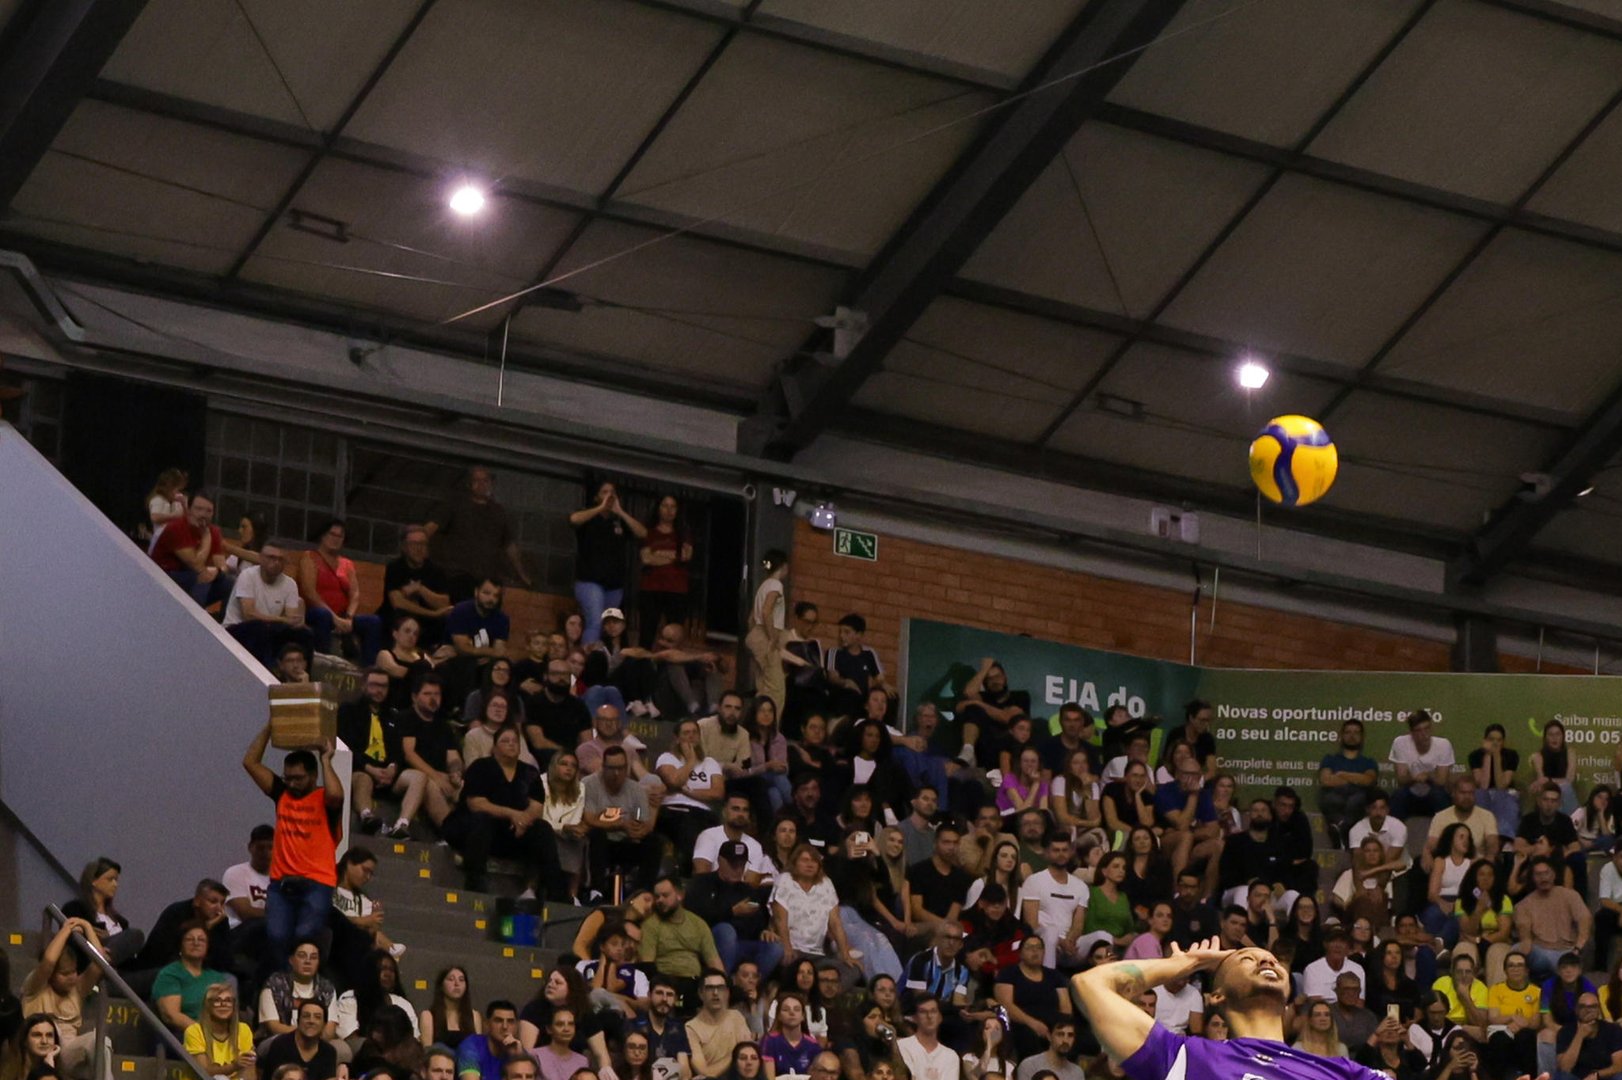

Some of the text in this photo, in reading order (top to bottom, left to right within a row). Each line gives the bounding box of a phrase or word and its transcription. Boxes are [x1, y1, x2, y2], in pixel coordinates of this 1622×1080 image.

[1045, 674, 1146, 719] EJA do
[1217, 704, 1268, 720] Novas
[1272, 705, 1393, 725] oportunidades
[1554, 713, 1622, 726] Saiba mais
[1216, 729, 1236, 740] ao
[1241, 730, 1270, 741] seu
[1565, 730, 1596, 744] 800
[1600, 731, 1621, 744] 05
[1216, 757, 1272, 772] Complete
[1276, 761, 1304, 770] seus
[1577, 756, 1612, 768] inheir
